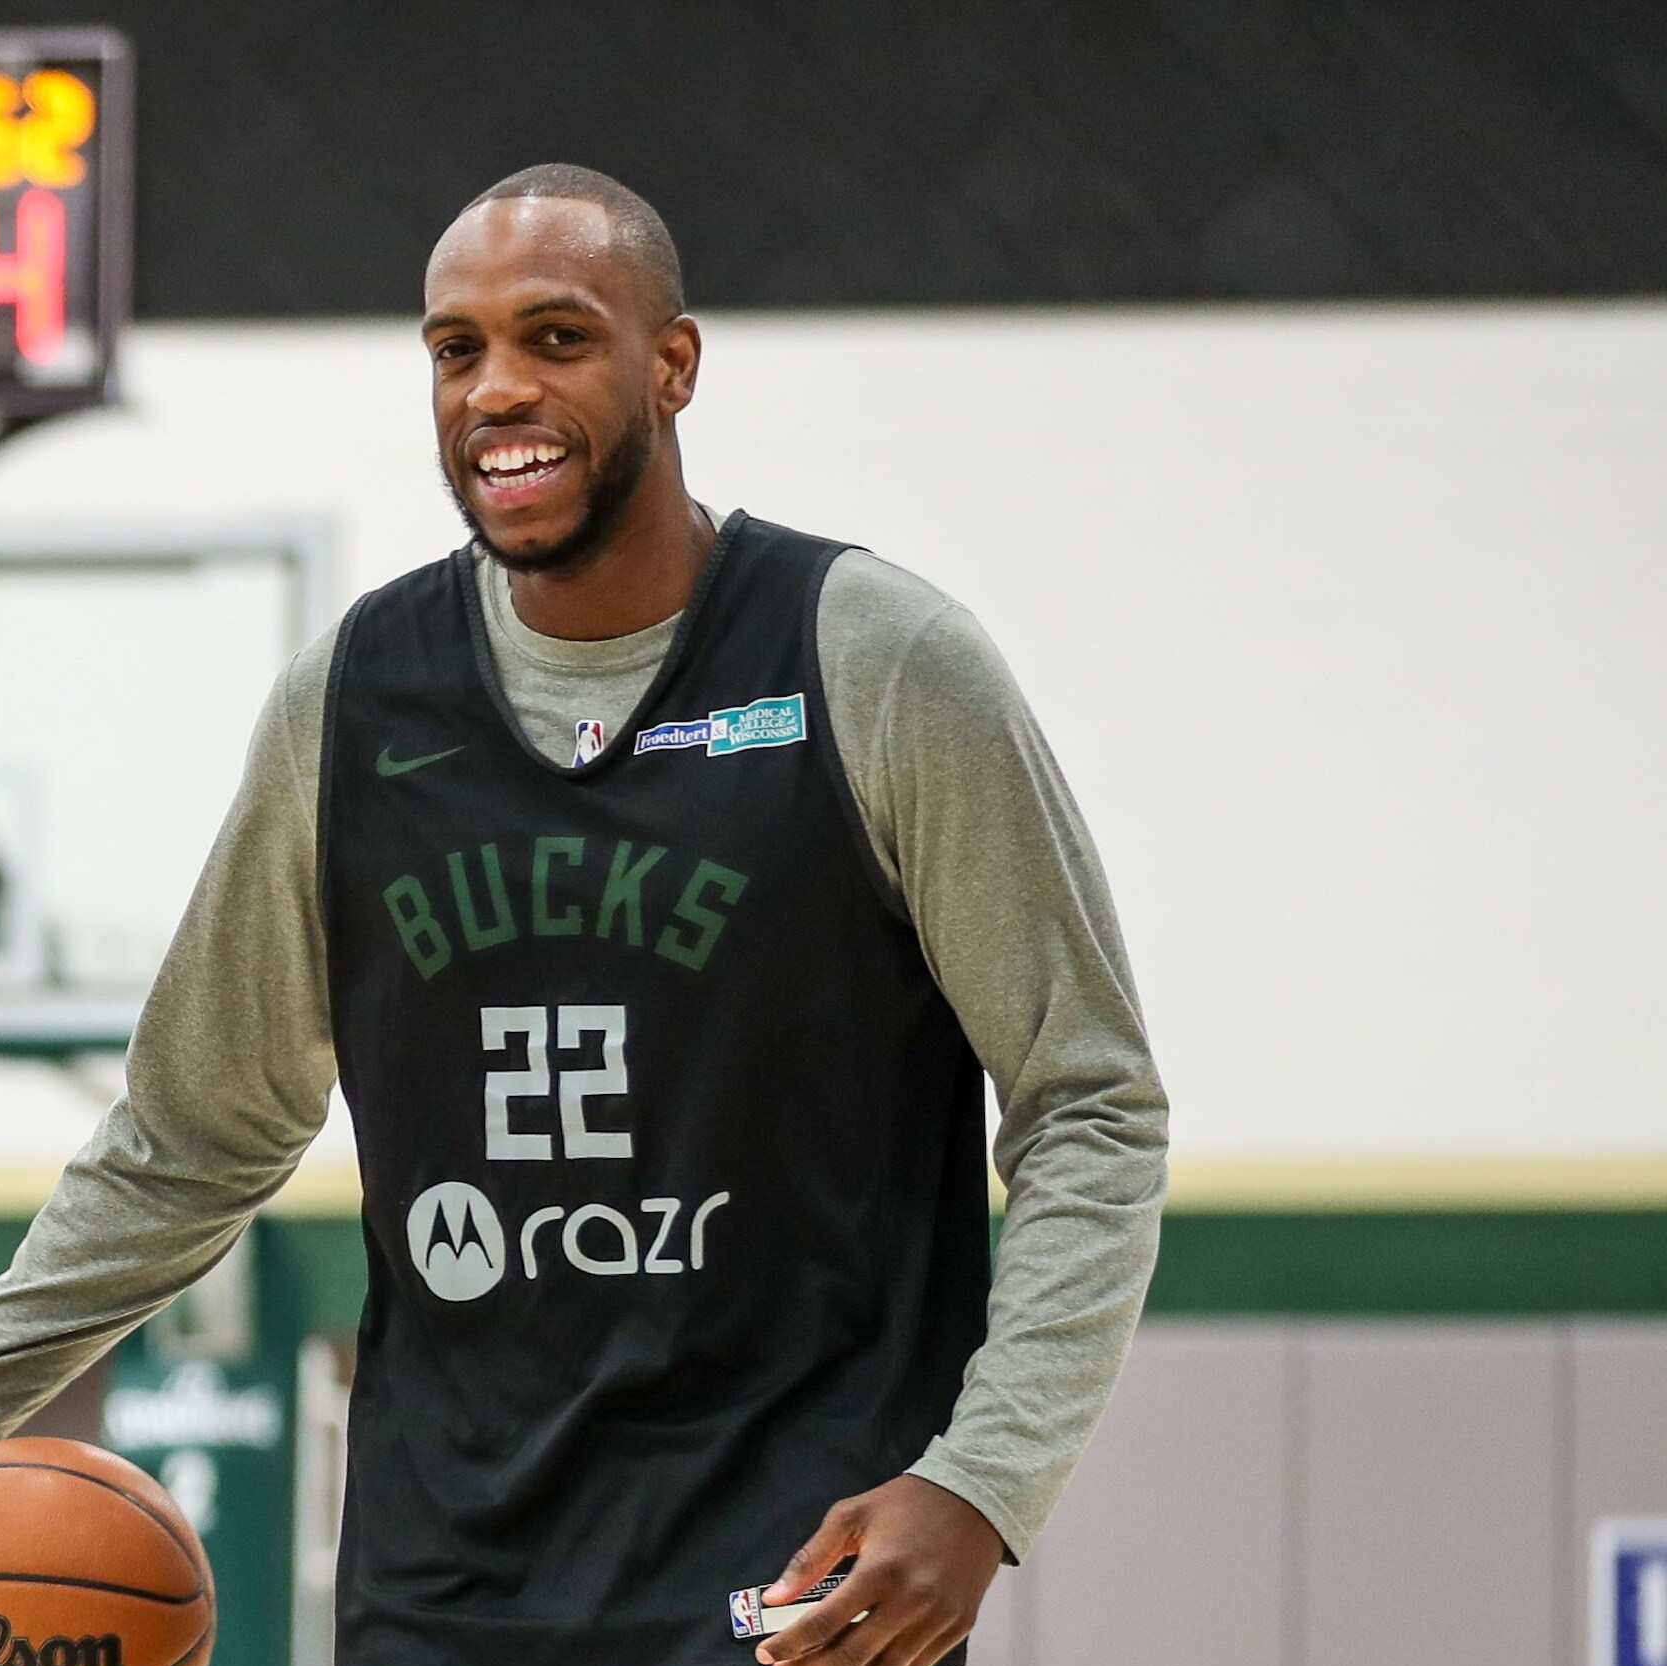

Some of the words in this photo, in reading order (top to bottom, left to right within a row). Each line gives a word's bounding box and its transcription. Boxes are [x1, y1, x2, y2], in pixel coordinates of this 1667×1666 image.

[640, 728, 709, 749] Froedtert
[739, 706, 795, 722] MEDICAL
[382, 836, 750, 981] BUCKS
[480, 1004, 633, 1161] 22
[520, 1191, 730, 1281] razr
